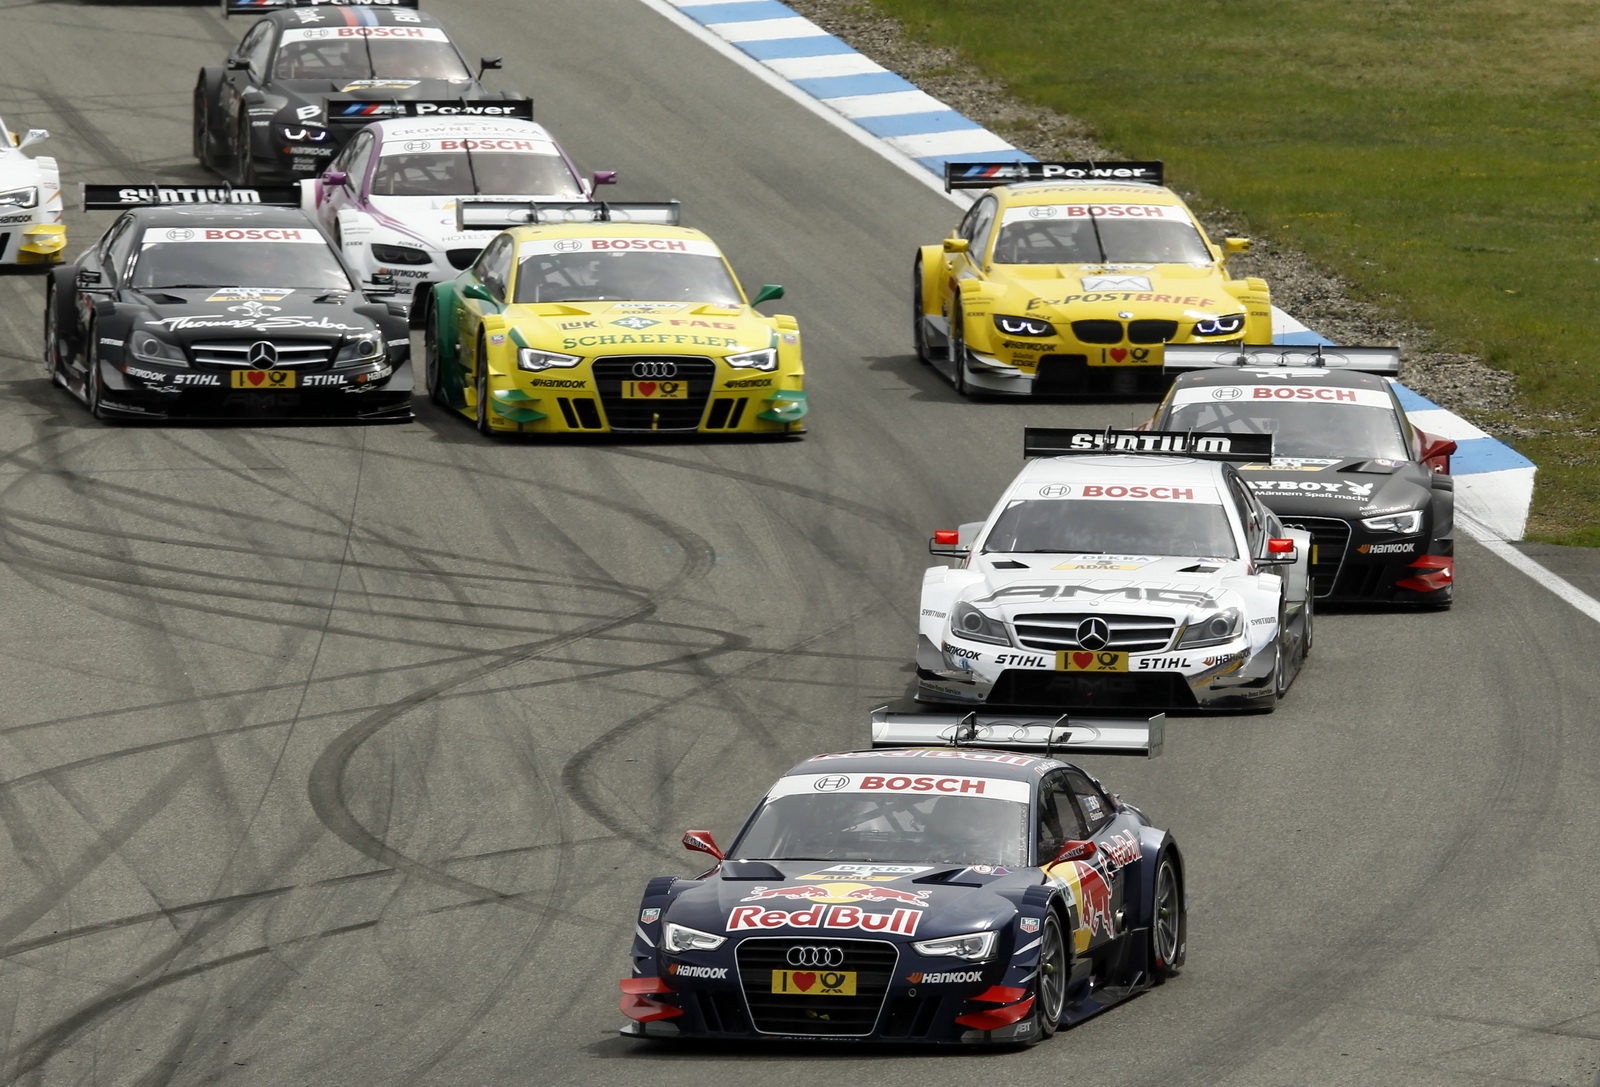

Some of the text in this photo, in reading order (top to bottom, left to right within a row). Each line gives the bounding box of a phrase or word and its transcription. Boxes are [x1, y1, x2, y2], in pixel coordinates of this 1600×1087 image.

[338, 28, 424, 37] BOSCH
[415, 103, 516, 115] Power
[440, 140, 534, 150] BOSCH
[1042, 165, 1146, 178] Power
[1067, 206, 1164, 217] BOSCH
[205, 229, 302, 240] BOSCH
[591, 239, 686, 251] BOSCH
[669, 319, 737, 330] FAG
[562, 333, 739, 350] SCHAEFFLER
[173, 374, 221, 386] STIHL
[302, 374, 348, 387] STIHL
[1253, 388, 1357, 402] BOSCH
[1250, 480, 1343, 492] AYBOY
[1082, 485, 1194, 500] BOSCH
[1334, 494, 1369, 502] macht
[994, 654, 1047, 668] STIHL
[1138, 657, 1192, 669] STIHL
[859, 776, 986, 794] BOSCH
[838, 865, 917, 873] DEKRA
[726, 904, 923, 937] Red Bull
[1013, 1021, 1032, 1036] ABT
